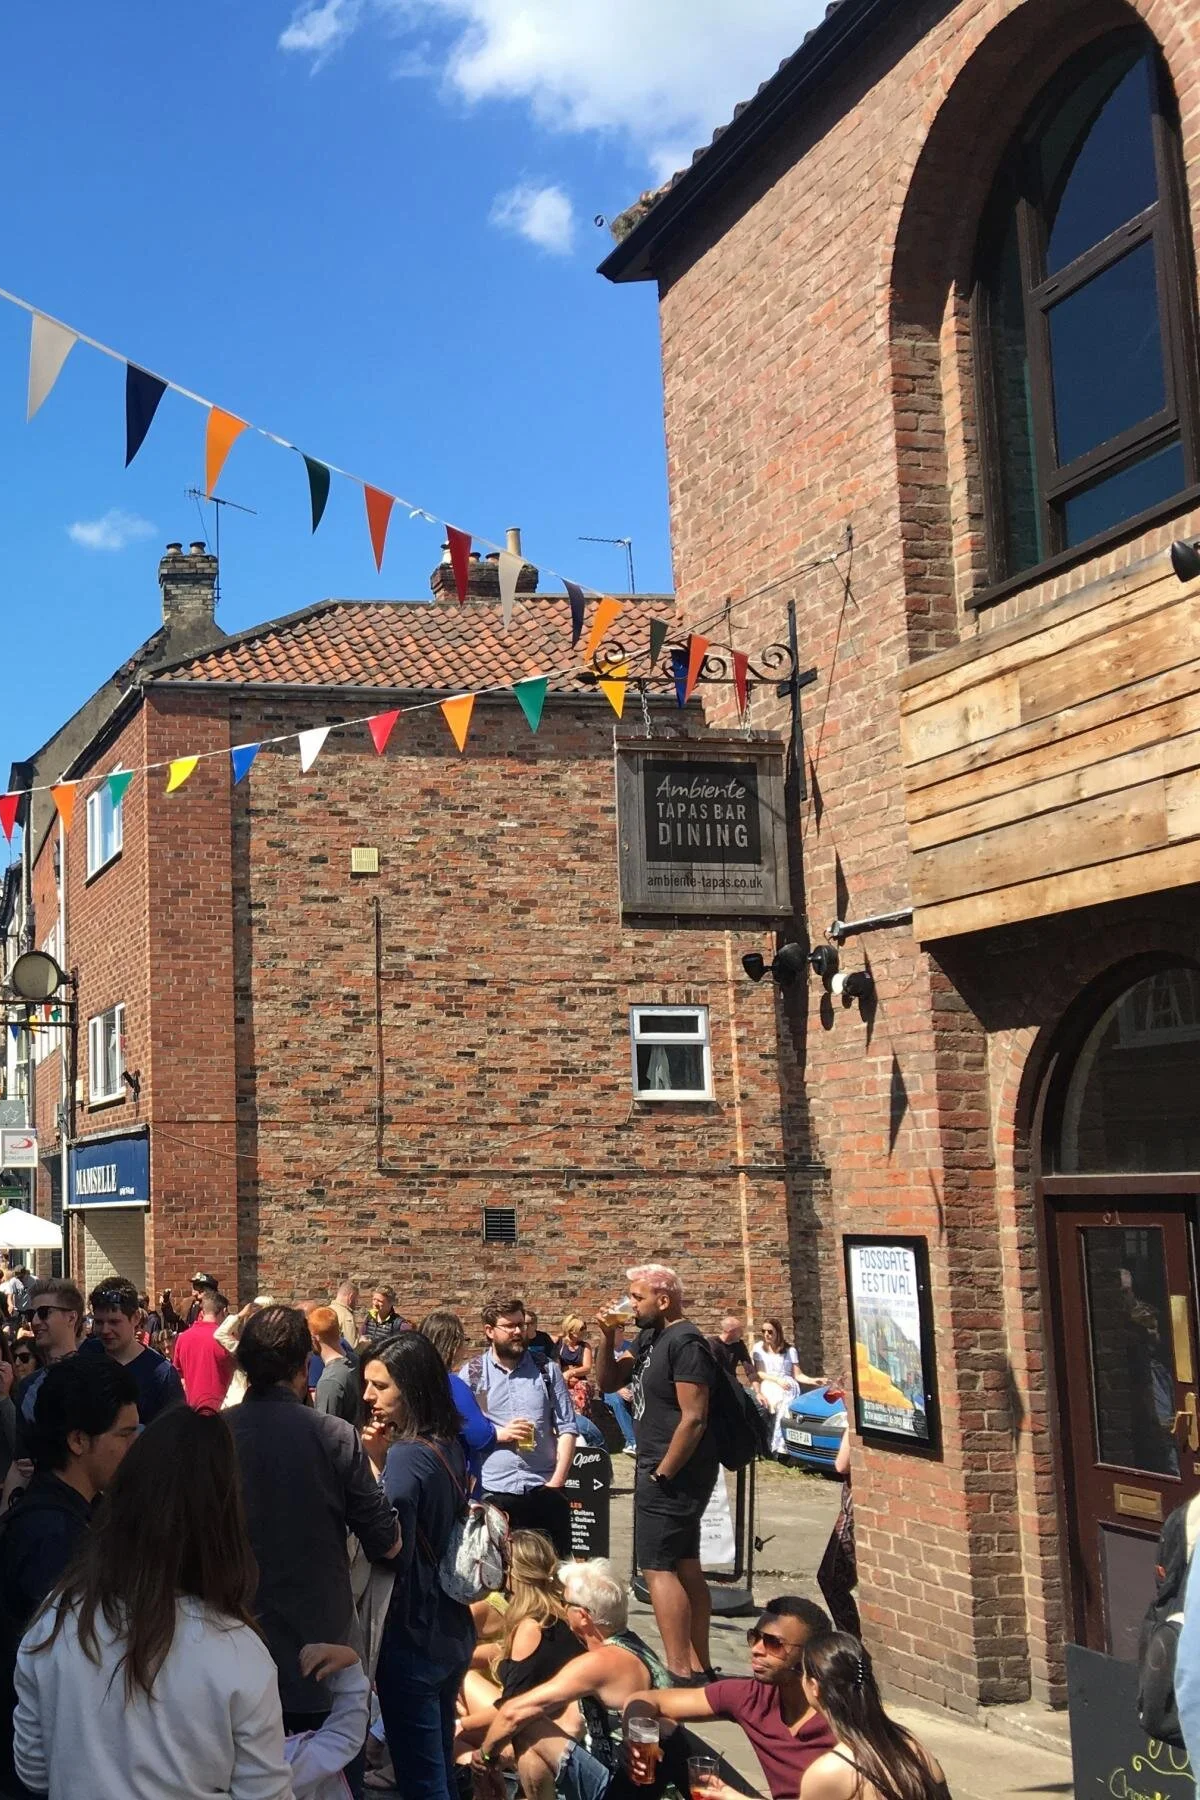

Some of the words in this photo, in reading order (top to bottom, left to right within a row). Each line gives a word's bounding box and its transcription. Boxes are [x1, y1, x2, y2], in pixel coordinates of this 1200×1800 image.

[656, 774, 746, 799] Ambiente
[657, 802, 708, 819] TAPAS
[714, 804, 746, 820] BAR
[658, 822, 748, 848] DINING
[647, 874, 763, 890] ambiente-tapas.co.uk
[859, 1249, 911, 1272] FOSSGATE
[861, 1272, 912, 1295] FESTIVAL
[573, 1452, 601, 1468] Open
[573, 1509, 595, 1517] Guitars
[574, 1516, 596, 1524] Guitars
